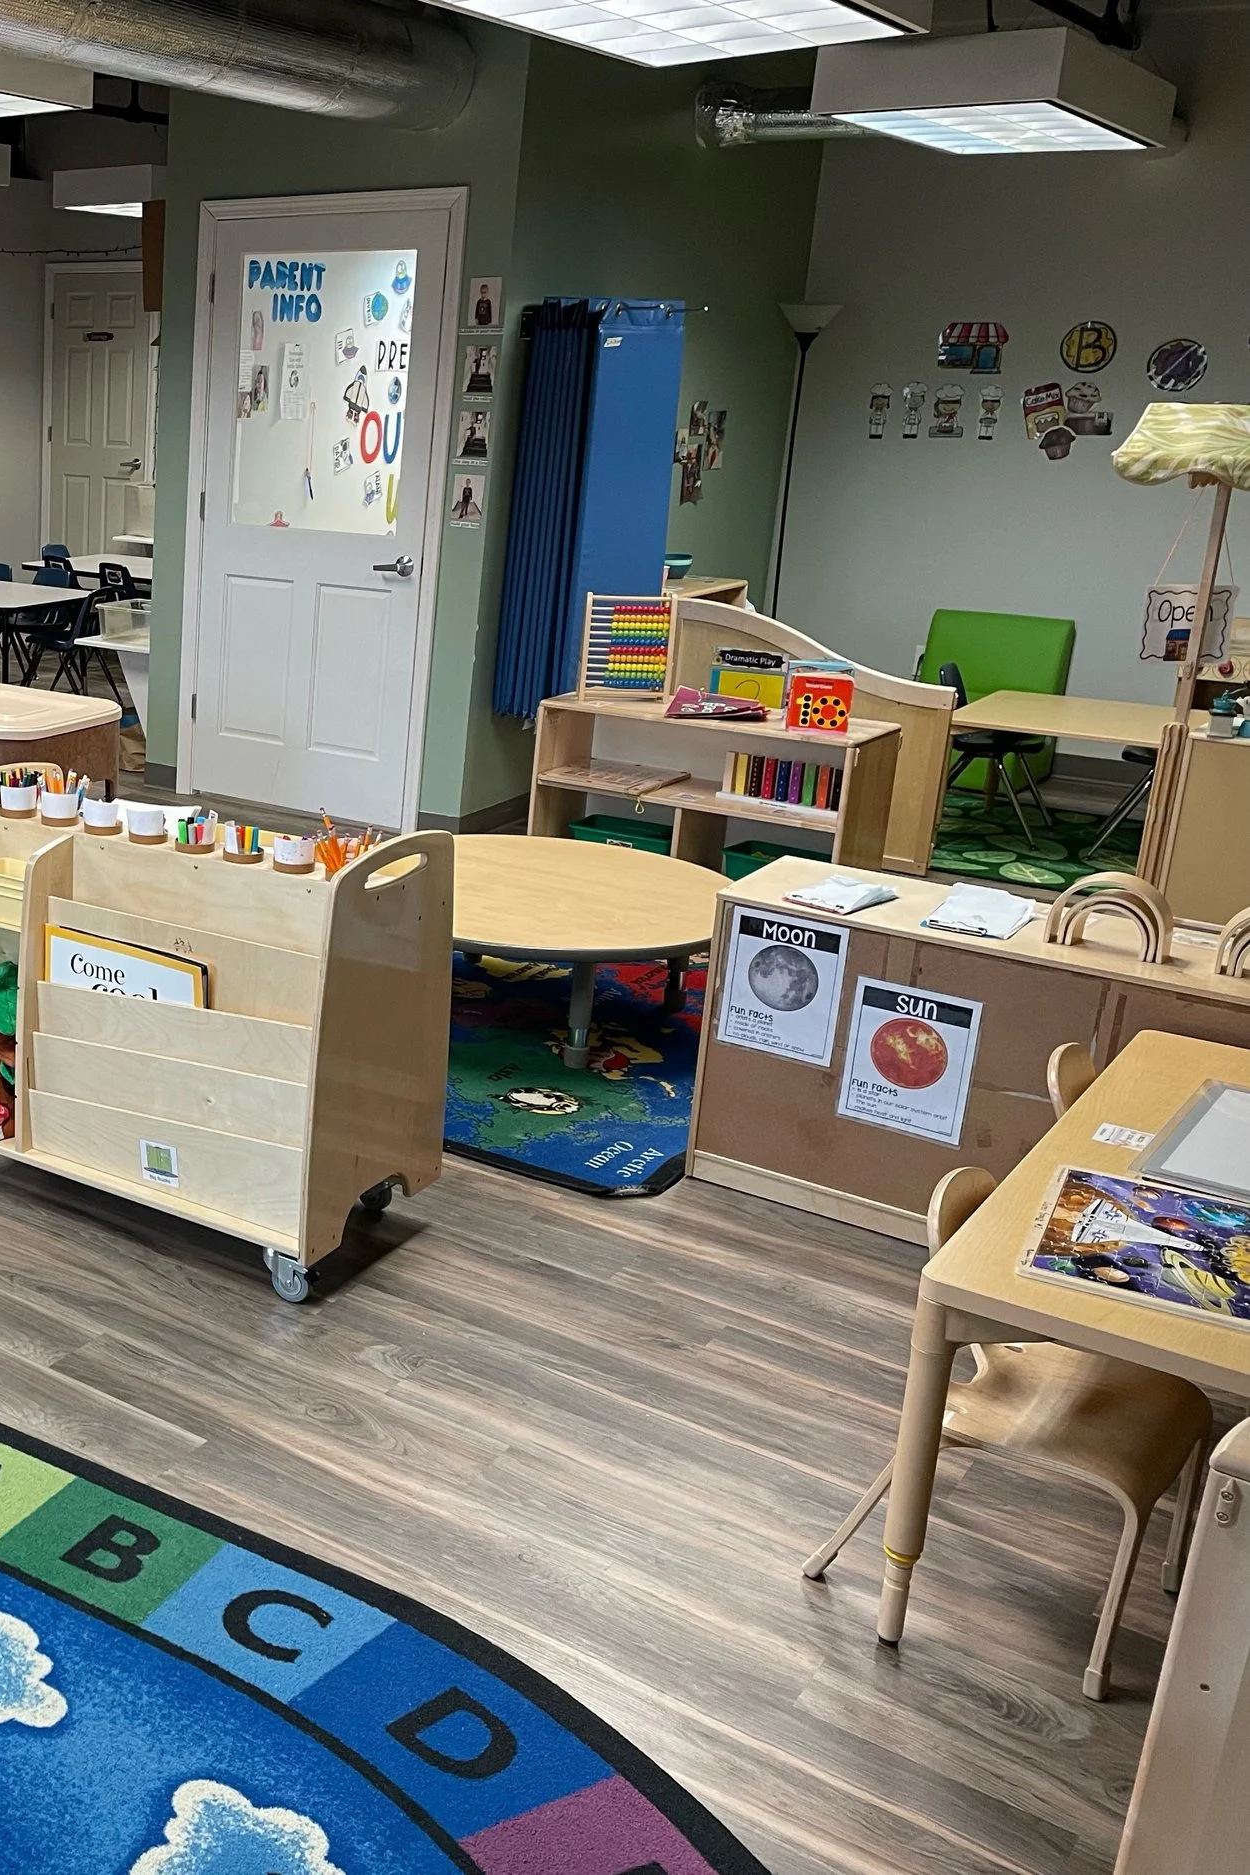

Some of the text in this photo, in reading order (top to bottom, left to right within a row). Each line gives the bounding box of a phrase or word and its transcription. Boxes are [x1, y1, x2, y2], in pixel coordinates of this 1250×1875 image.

[248, 260, 327, 291] PARENT
[272, 293, 322, 323] INFO
[377, 340, 408, 370] PRE
[1045, 390, 1060, 401] Mix
[725, 653, 777, 667] Dramatic Play
[796, 693, 848, 729] 10
[762, 921, 816, 948] Moon
[70, 953, 126, 985] Come
[584, 1140, 634, 1169] Ocean
[616, 1147, 665, 1178] Arctic
[60, 1514, 162, 1584] B
[222, 1590, 335, 1664] C
[385, 1685, 518, 1780] D
